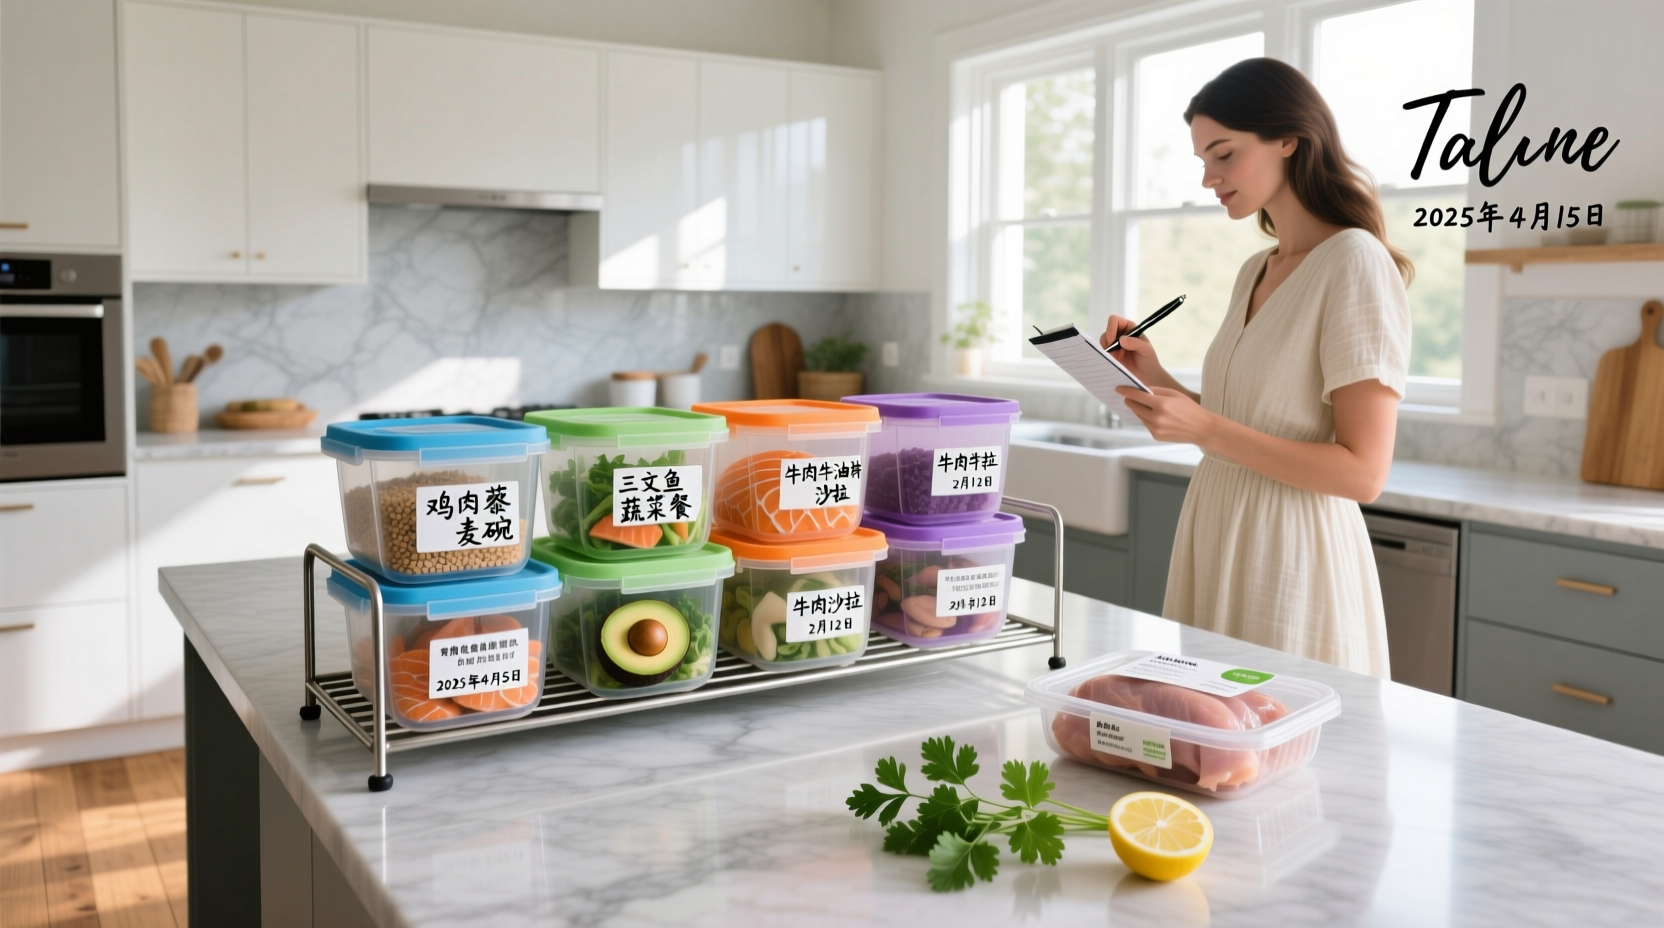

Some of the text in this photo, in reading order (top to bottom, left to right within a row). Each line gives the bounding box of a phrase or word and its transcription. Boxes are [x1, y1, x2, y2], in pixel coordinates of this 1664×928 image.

[619, 469, 683, 493] 三文鱼
[952, 476, 992, 490] 2月12日
[815, 483, 851, 505] 沙拉
[620, 493, 692, 523] 蔬菜餐
[456, 515, 513, 547] 麦碗
[793, 591, 863, 616] 牛肉沙拉
[809, 617, 852, 635] 2月12日
[436, 669, 521, 692] 2025年4月5日
